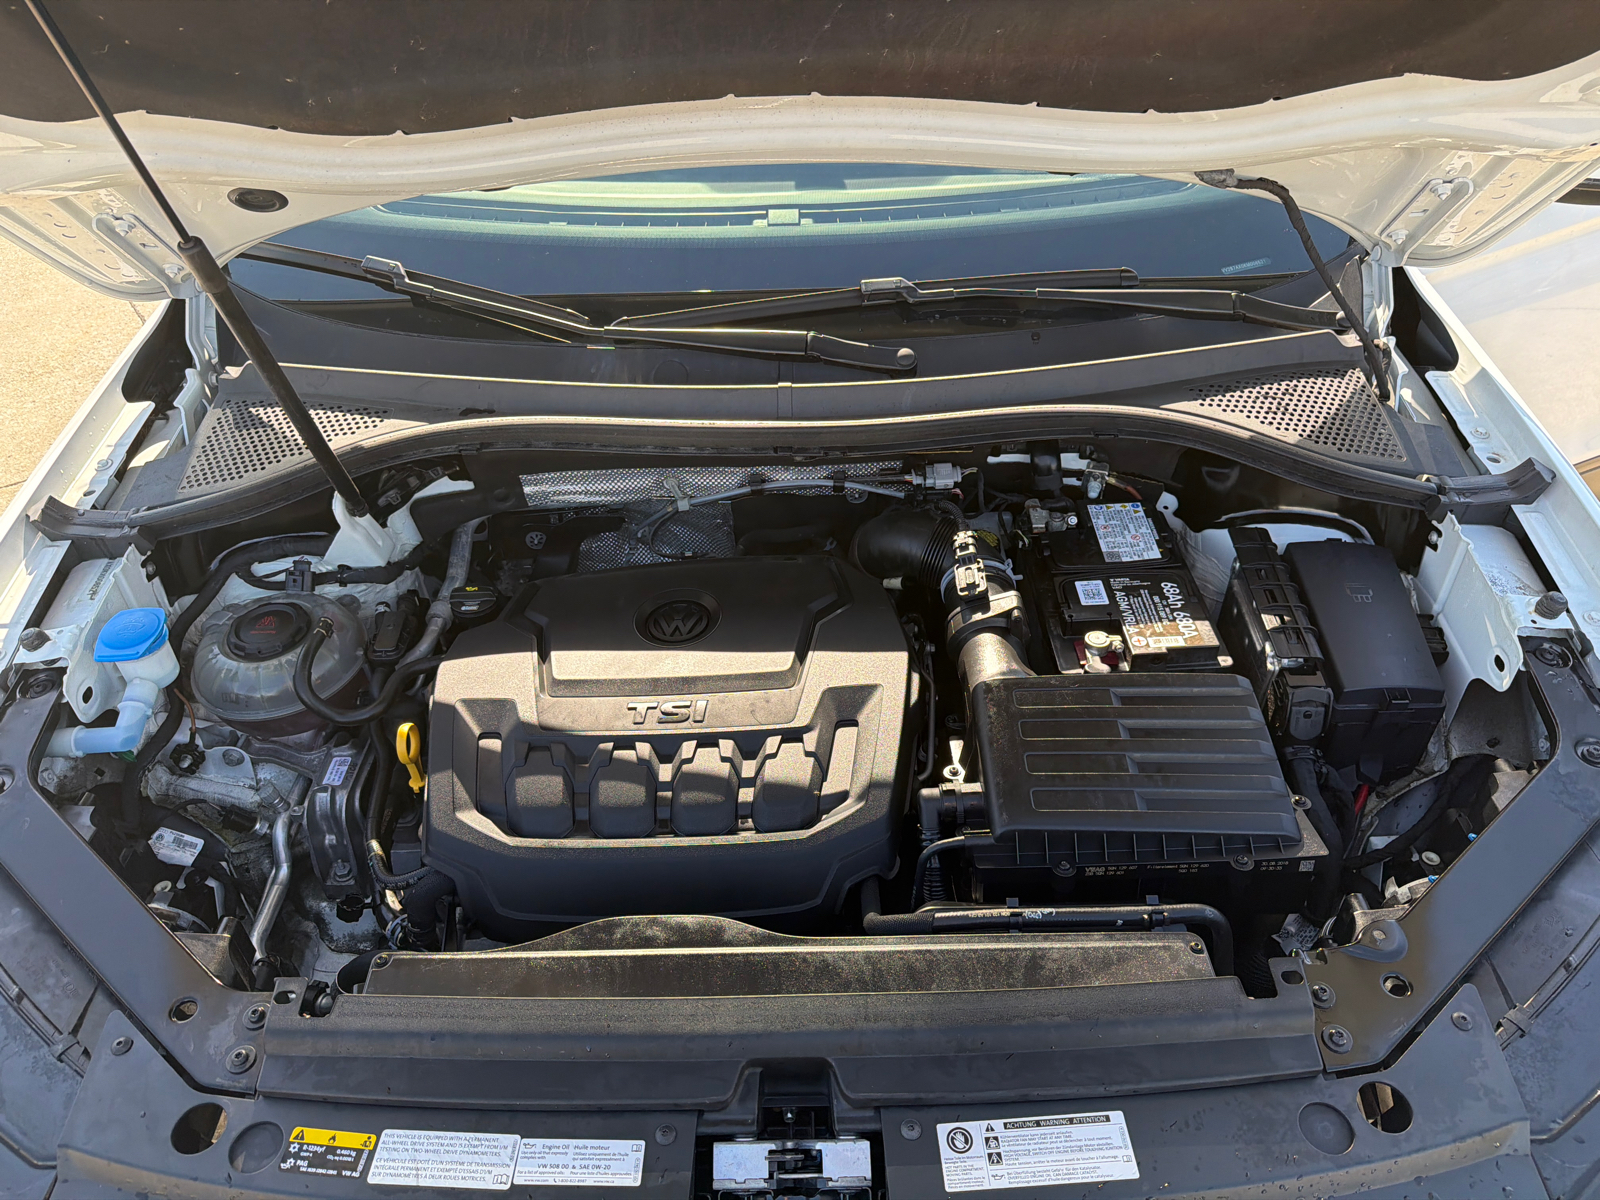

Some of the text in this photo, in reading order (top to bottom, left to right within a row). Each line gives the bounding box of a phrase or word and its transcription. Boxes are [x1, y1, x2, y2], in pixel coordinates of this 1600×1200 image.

[648, 602, 708, 641] VW
[1161, 582, 1185, 608] 68Ah
[1173, 612, 1199, 638] 680A
[627, 700, 709, 725] TSI
[302, 1144, 326, 1153] R-1234yf
